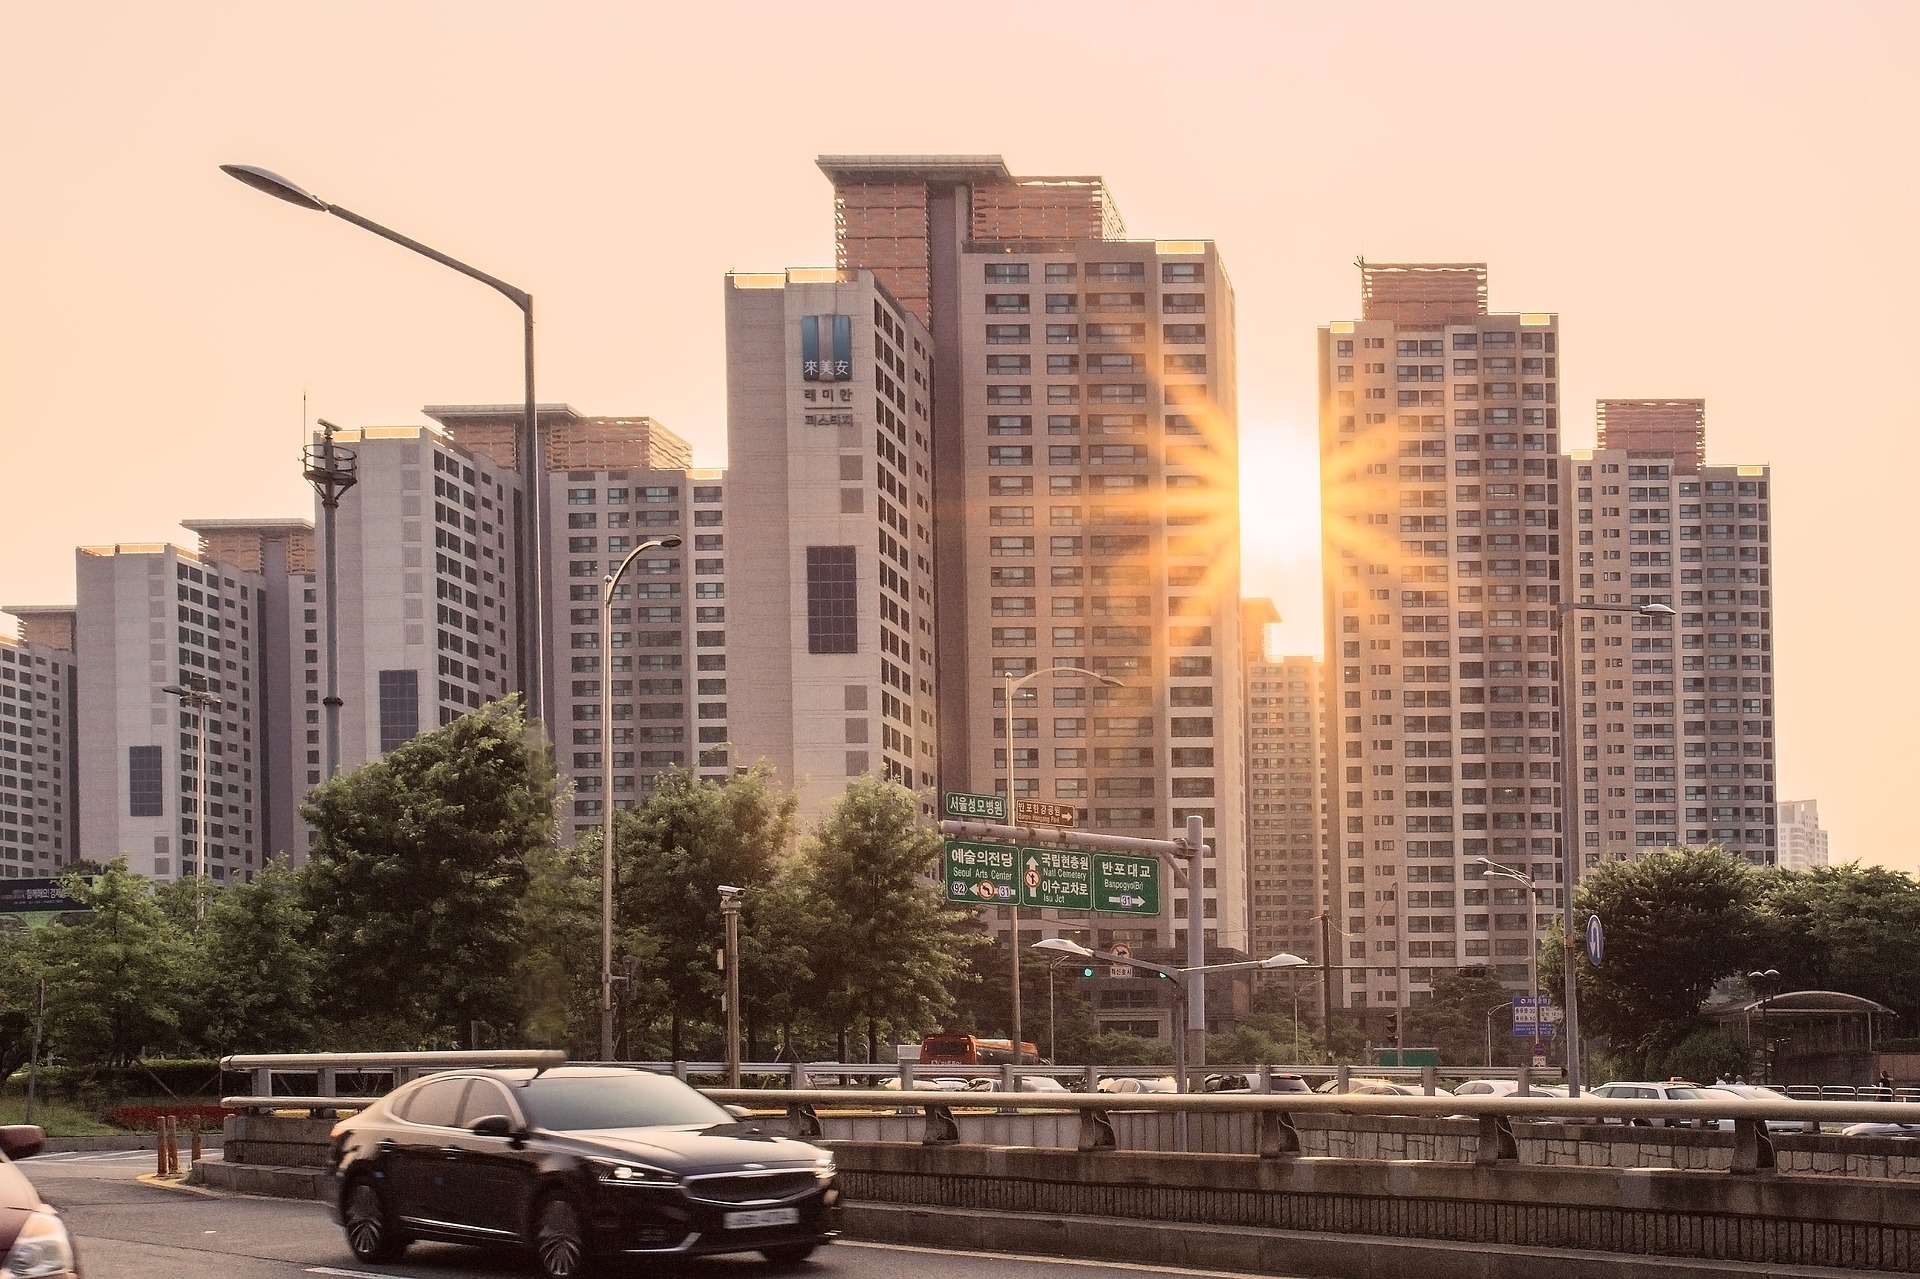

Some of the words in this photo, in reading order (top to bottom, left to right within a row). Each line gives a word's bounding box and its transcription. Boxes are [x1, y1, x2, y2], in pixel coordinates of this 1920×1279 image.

[804, 360, 849, 376] 來美安
[804, 388, 852, 402] 래미안
[950, 796, 1003, 816] 서울성모병원
[1018, 802, 1061, 816] 반포한강공원
[951, 848, 1013, 867] 예술의전당
[1041, 853, 1089, 870] 국립현충원
[953, 866, 972, 877] Seoul
[975, 868, 988, 879] Arts
[991, 869, 1012, 880] Center
[1058, 868, 1086, 881] Cemetery
[1102, 861, 1150, 877] 반포대교
[954, 883, 964, 892] 92
[1000, 886, 1010, 896] 31
[1042, 879, 1089, 896] 이수교차로
[1043, 893, 1053, 903] Isu
[1054, 894, 1065, 903] Jct
[1122, 896, 1132, 905] 31
